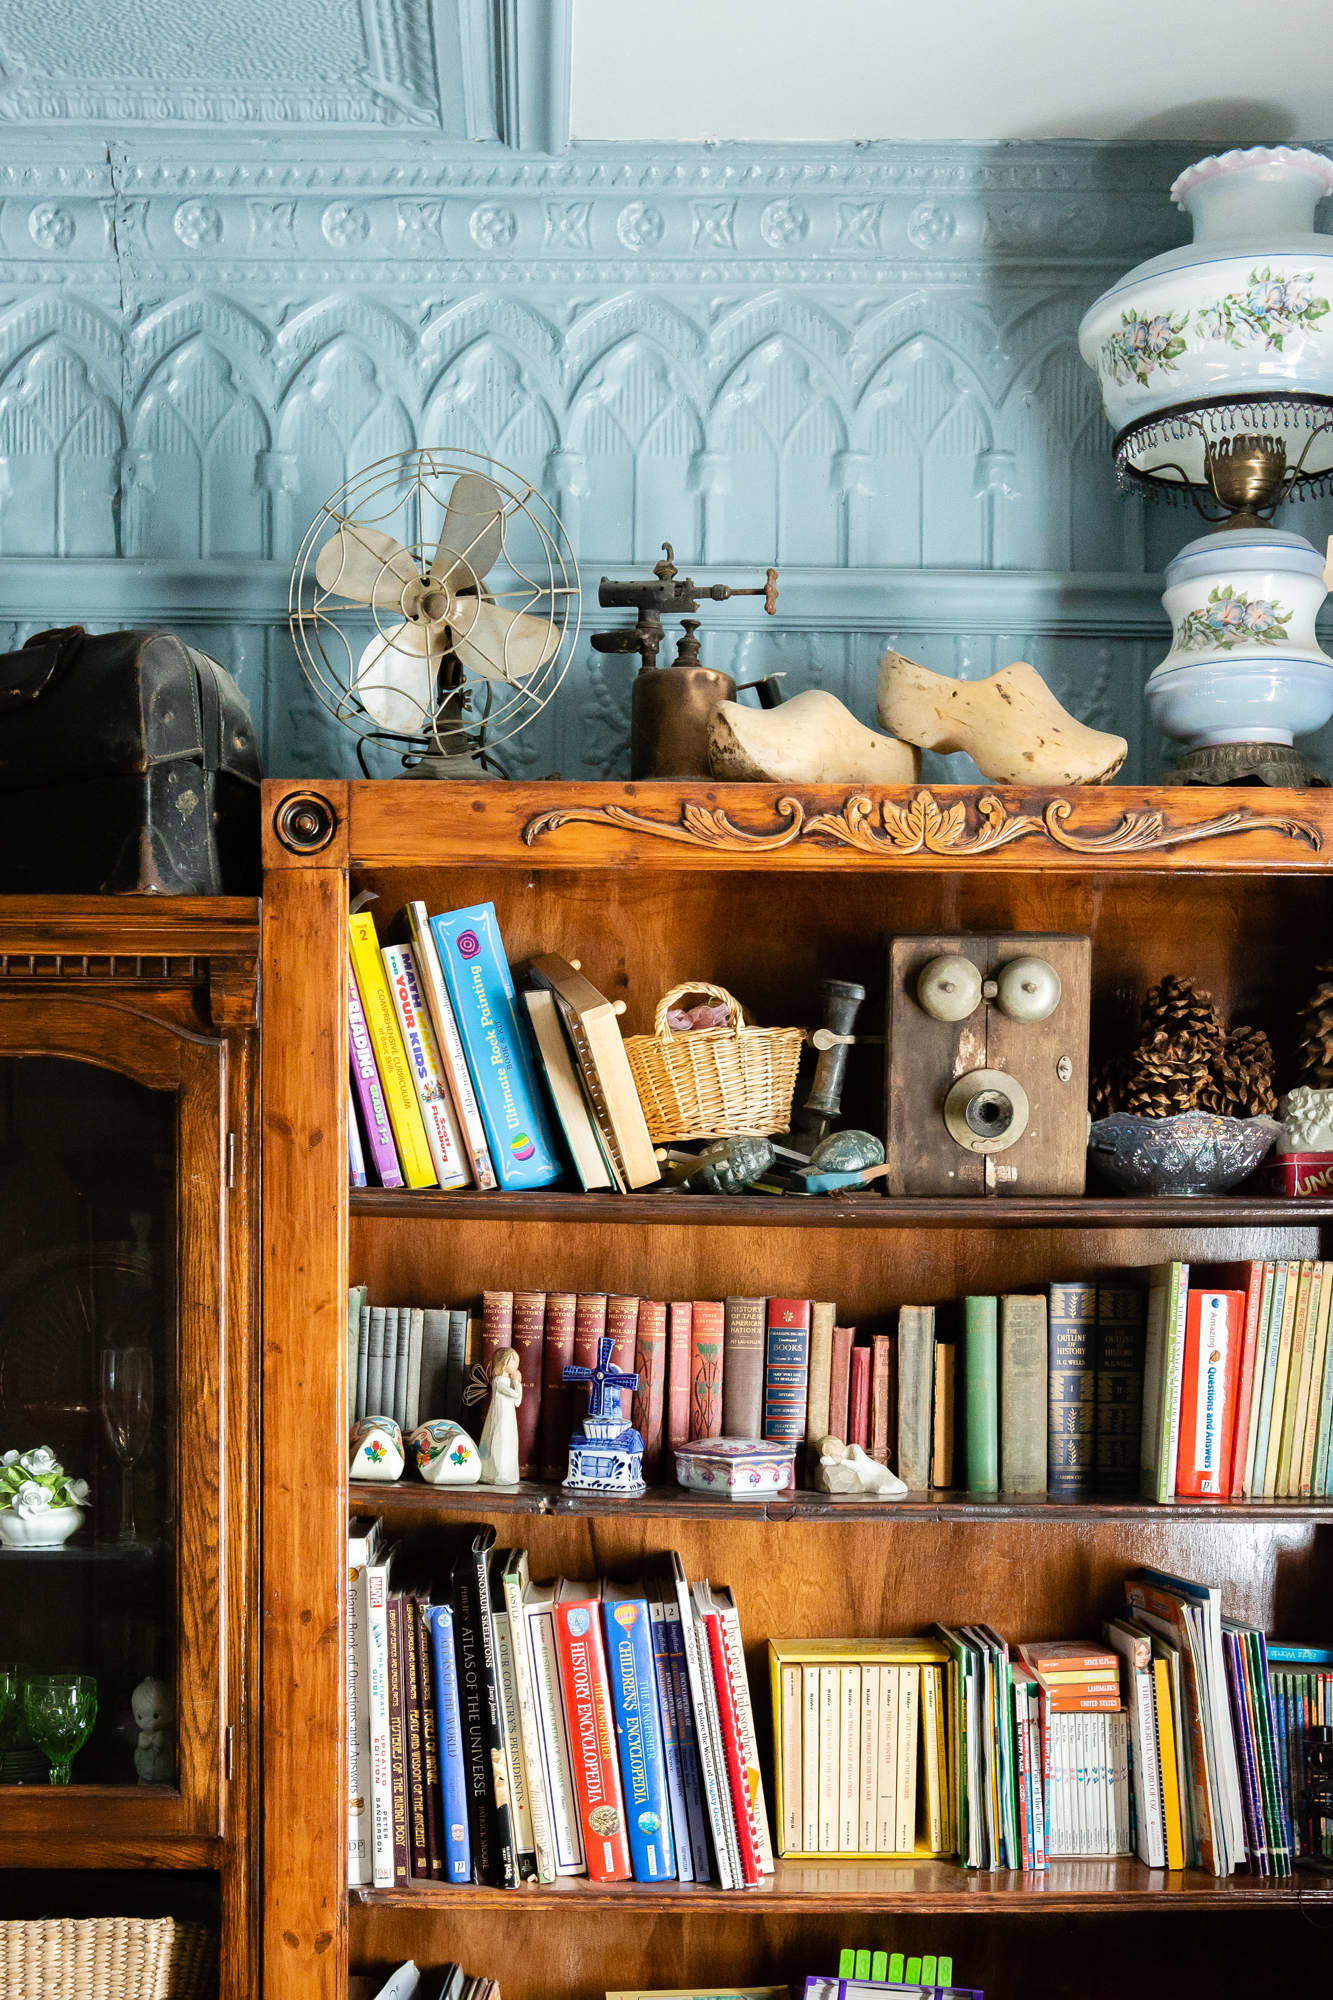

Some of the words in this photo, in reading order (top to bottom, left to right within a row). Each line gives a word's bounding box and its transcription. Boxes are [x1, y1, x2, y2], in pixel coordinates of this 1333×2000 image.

[360, 930, 368, 940] 2
[472, 966, 493, 1027] Painting
[390, 956, 398, 974] FOR
[395, 975, 415, 1027] YOUR
[408, 1032, 427, 1077] KIDS
[402, 953, 420, 1006] MATH
[416, 1011, 438, 1074] MAGIC
[494, 1019, 503, 1034] KIT
[348, 999, 374, 1079] READING
[376, 989, 397, 1053] COMPREHENSIVE
[393, 1056, 410, 1108] CURRICULUM
[448, 1017, 464, 1060] decorating
[485, 1029, 502, 1065] Rock
[502, 1046, 512, 1069] BOOK
[465, 1087, 475, 1115] debbie
[498, 1068, 519, 1128] Ultimate
[432, 1105, 447, 1161] Flansburg
[440, 1118, 450, 1146] Scott
[1206, 1312, 1216, 1347] Amazing
[1246, 1293, 1256, 1343] DALMATIANS
[1272, 1320, 1280, 1341] LITTLE
[1294, 1307, 1304, 1352] RESCUERS
[1207, 1367, 1217, 1411] Questions
[1206, 1412, 1214, 1431] and
[1204, 1431, 1213, 1469] Answers
[347, 1588, 357, 1617] Giant
[368, 1577, 382, 1607] MARVEL
[476, 1564, 487, 1612] DINOSAUR
[669, 1608, 674, 1616] 2
[347, 1623, 357, 1648] Book
[481, 1614, 492, 1667] SKELETONS
[726, 1615, 738, 1640] The
[348, 1654, 358, 1667] of
[440, 1637, 452, 1669] ATLAS
[462, 1627, 474, 1668] ATLAS
[500, 1644, 510, 1667] OUR
[730, 1645, 742, 1679] Great
[443, 1673, 453, 1687] OF
[465, 1671, 476, 1689] OF
[570, 1642, 588, 1701] HISTORY
[619, 1641, 637, 1711] CHILDREN'S
[347, 1670, 358, 1722] Questions
[444, 1692, 454, 1712] THE
[502, 1671, 516, 1732] COUNTRY'S
[594, 1681, 604, 1700] THE
[639, 1681, 649, 1699] THE
[410, 1709, 419, 1730] FEATS
[468, 1695, 478, 1720] THE
[348, 1726, 358, 1745] and
[391, 1717, 402, 1758] MYSTERIES
[424, 1708, 434, 1738] FORCES
[446, 1715, 457, 1756] WORLD
[596, 1703, 610, 1758] KINGFISHER
[642, 1703, 656, 1758] KINGFISHER
[737, 1684, 752, 1762] Philosophers
[1144, 1703, 1152, 1753] WONDERFUL
[410, 1733, 420, 1749] AND
[425, 1741, 434, 1751] OF
[578, 1703, 601, 1803] ENCYCLOPEDIA
[350, 1751, 358, 1793] Answers
[392, 1762, 402, 1773] OF
[411, 1751, 421, 1781] WISDOM
[426, 1756, 434, 1784] NATURE
[469, 1725, 484, 1795] UNIVERSE
[510, 1737, 524, 1801] PRESIDENTS
[627, 1717, 647, 1804] ENCYCLOPEDIA
[696, 1702, 706, 1734] Explore
[704, 1746, 712, 1767] World
[708, 1778, 716, 1805] Mighty
[712, 1807, 722, 1836] Oceans
[393, 1777, 403, 1792] THE
[412, 1783, 422, 1793] OF
[1149, 1787, 1156, 1796] OF
[394, 1795, 404, 1821] HUMAN
[414, 1796, 422, 1811] THE
[1150, 1799, 1156, 1810] OZ
[394, 1825, 404, 1845] BODY
[414, 1812, 424, 1846] ANCIENTS
[478, 1806, 486, 1836] PATRICK
[480, 1840, 488, 1868] MOORE
[504, 1863, 512, 1879] Kids
